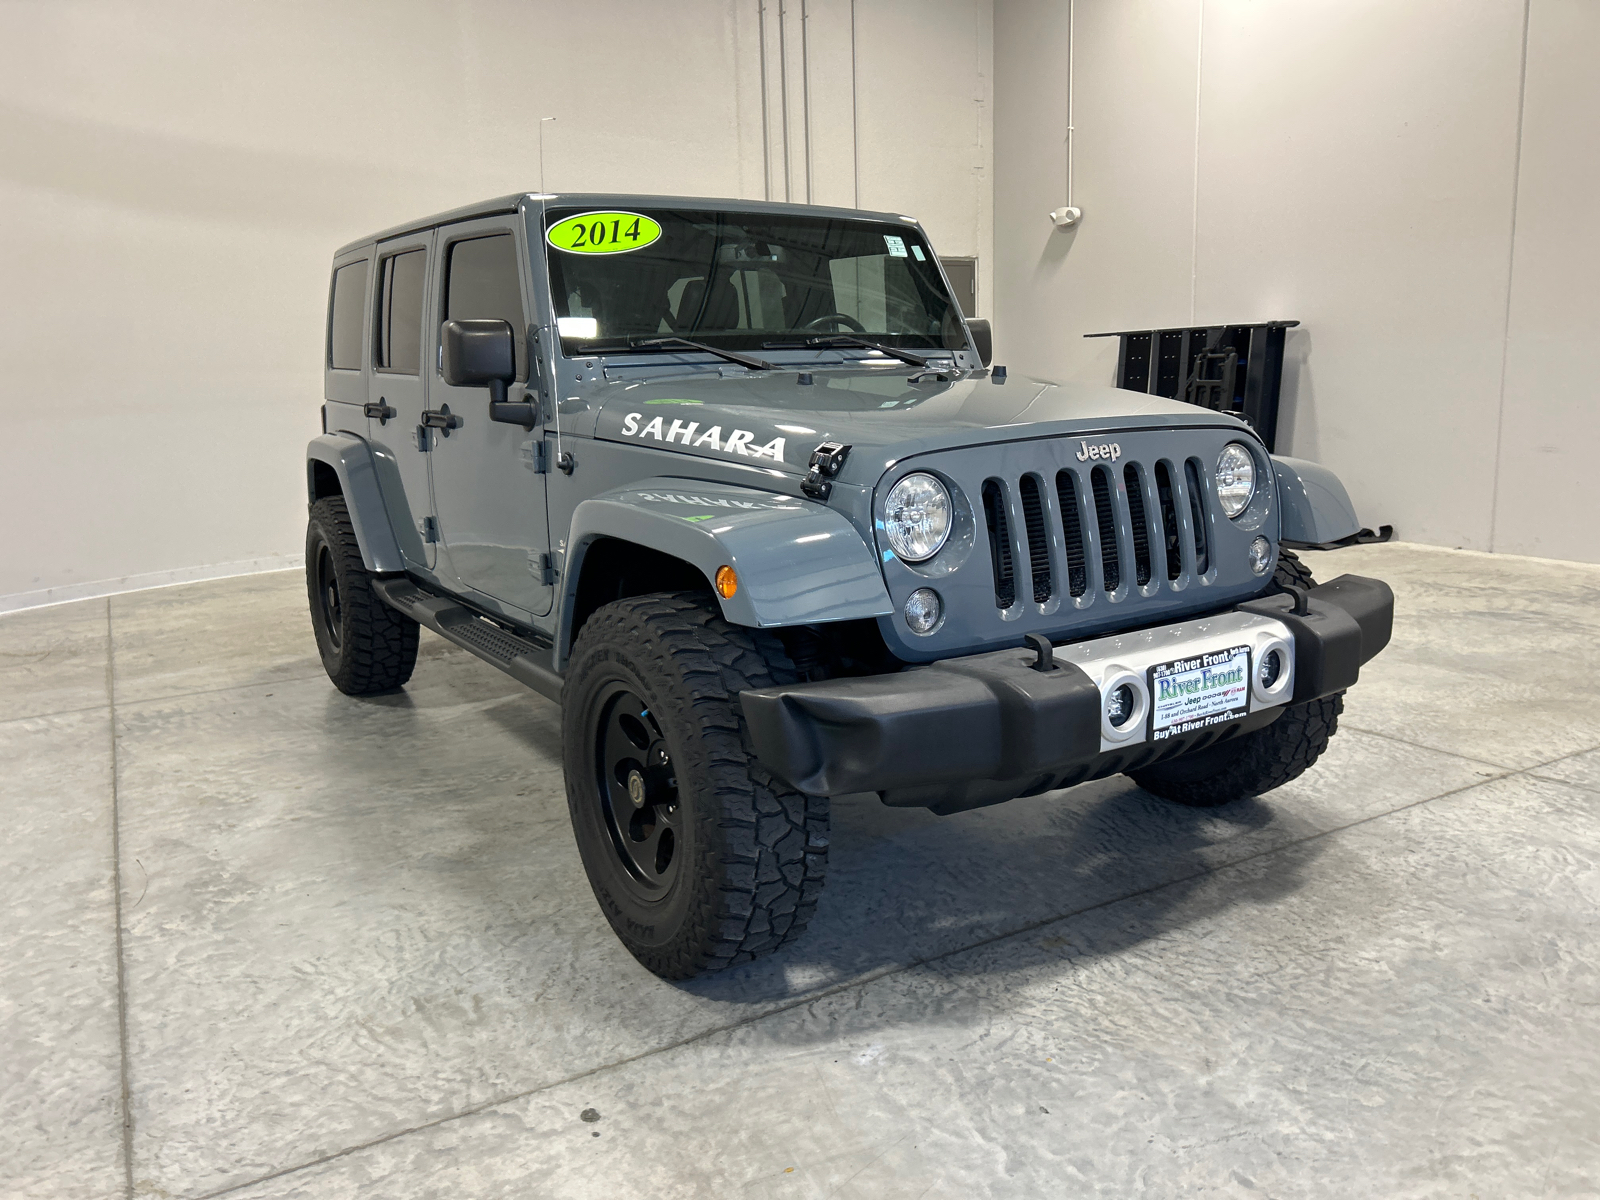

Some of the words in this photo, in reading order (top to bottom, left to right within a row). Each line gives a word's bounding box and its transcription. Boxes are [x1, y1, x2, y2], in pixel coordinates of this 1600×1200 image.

[571, 217, 641, 248] 2014
[621, 412, 786, 463] SAHARA
[1075, 441, 1121, 463] Jeep
[1174, 659, 1201, 673] River
[1203, 651, 1229, 666] Front
[1171, 709, 1180, 718] and
[1180, 705, 1198, 715] Orchard
[1198, 702, 1209, 711] Road
[1184, 696, 1201, 706] Jeep
[1153, 730, 1170, 741] Buy
[1171, 725, 1182, 736] At
[1182, 719, 1205, 733] River
